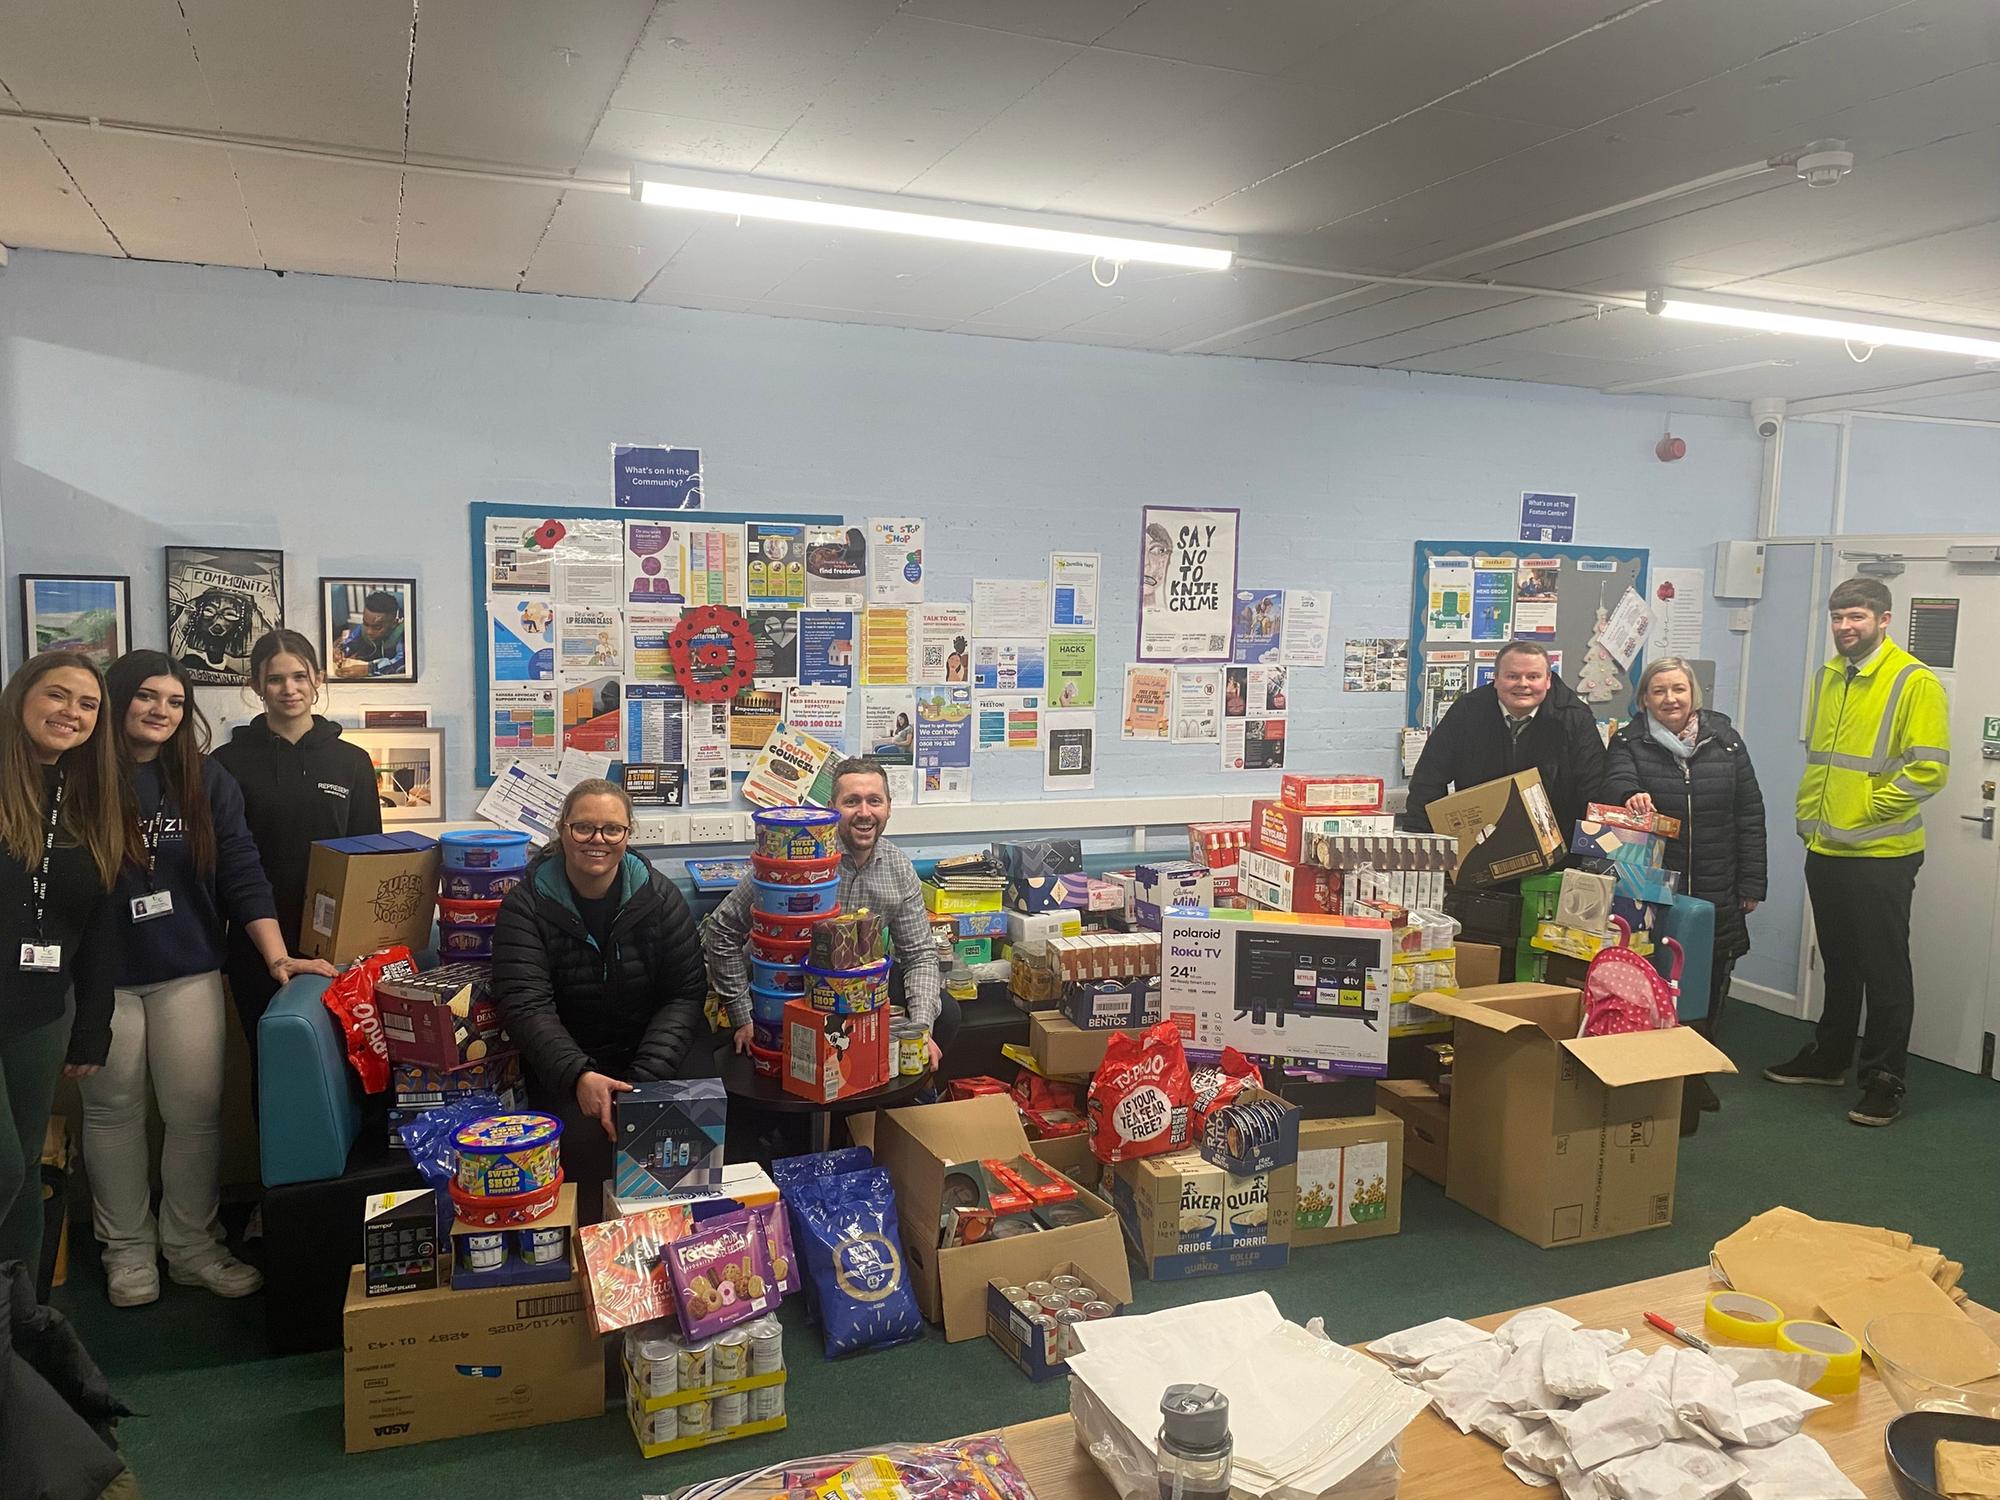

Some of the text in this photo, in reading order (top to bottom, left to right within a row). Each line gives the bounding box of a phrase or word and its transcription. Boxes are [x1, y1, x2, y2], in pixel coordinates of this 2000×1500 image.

[625, 466, 653, 474] What's
[676, 468, 690, 476] the
[632, 478, 683, 488] Community?
[1548, 509, 1568, 517] Centre?
[876, 525, 920, 534] ONE STOP
[885, 534, 911, 544] SHOP
[1177, 525, 1216, 549] SAY
[1182, 549, 1208, 566] NO
[834, 567, 861, 575] freedom
[1179, 566, 1203, 582] TO
[1170, 580, 1218, 597] KNIFE
[1169, 596, 1218, 612] CRIME
[1444, 678, 1461, 687] ART
[779, 739, 814, 762] YOUTH
[768, 745, 815, 774] COUNCIL
[791, 846, 815, 855] SHOP
[377, 874, 424, 899] SUPER
[1173, 928, 1221, 939] polaroid
[1171, 946, 1221, 958] Roku TV
[1088, 1017, 1127, 1027] BENTOS
[1141, 1015, 1160, 1024] BEN
[1122, 1089, 1157, 1115] IS YOUR
[1120, 1100, 1167, 1129] TEA FEAR
[656, 1128, 689, 1137] REVIVE
[1132, 1116, 1162, 1140] FREE?
[1207, 1118, 1216, 1147] RAY
[1630, 1121, 1643, 1145] 0.4L
[488, 1168, 520, 1178] SWEET
[488, 1177, 520, 1188] SHOP
[1180, 1195, 1221, 1210] AKER
[1227, 1190, 1269, 1210] QUAK
[1178, 1241, 1212, 1253] RRIDGE
[1233, 1236, 1267, 1248] PORRID
[1184, 1262, 1219, 1274] QUAKER
[488, 1316, 576, 1336] 14/10/2025
[374, 1422, 411, 1437] ASDA
